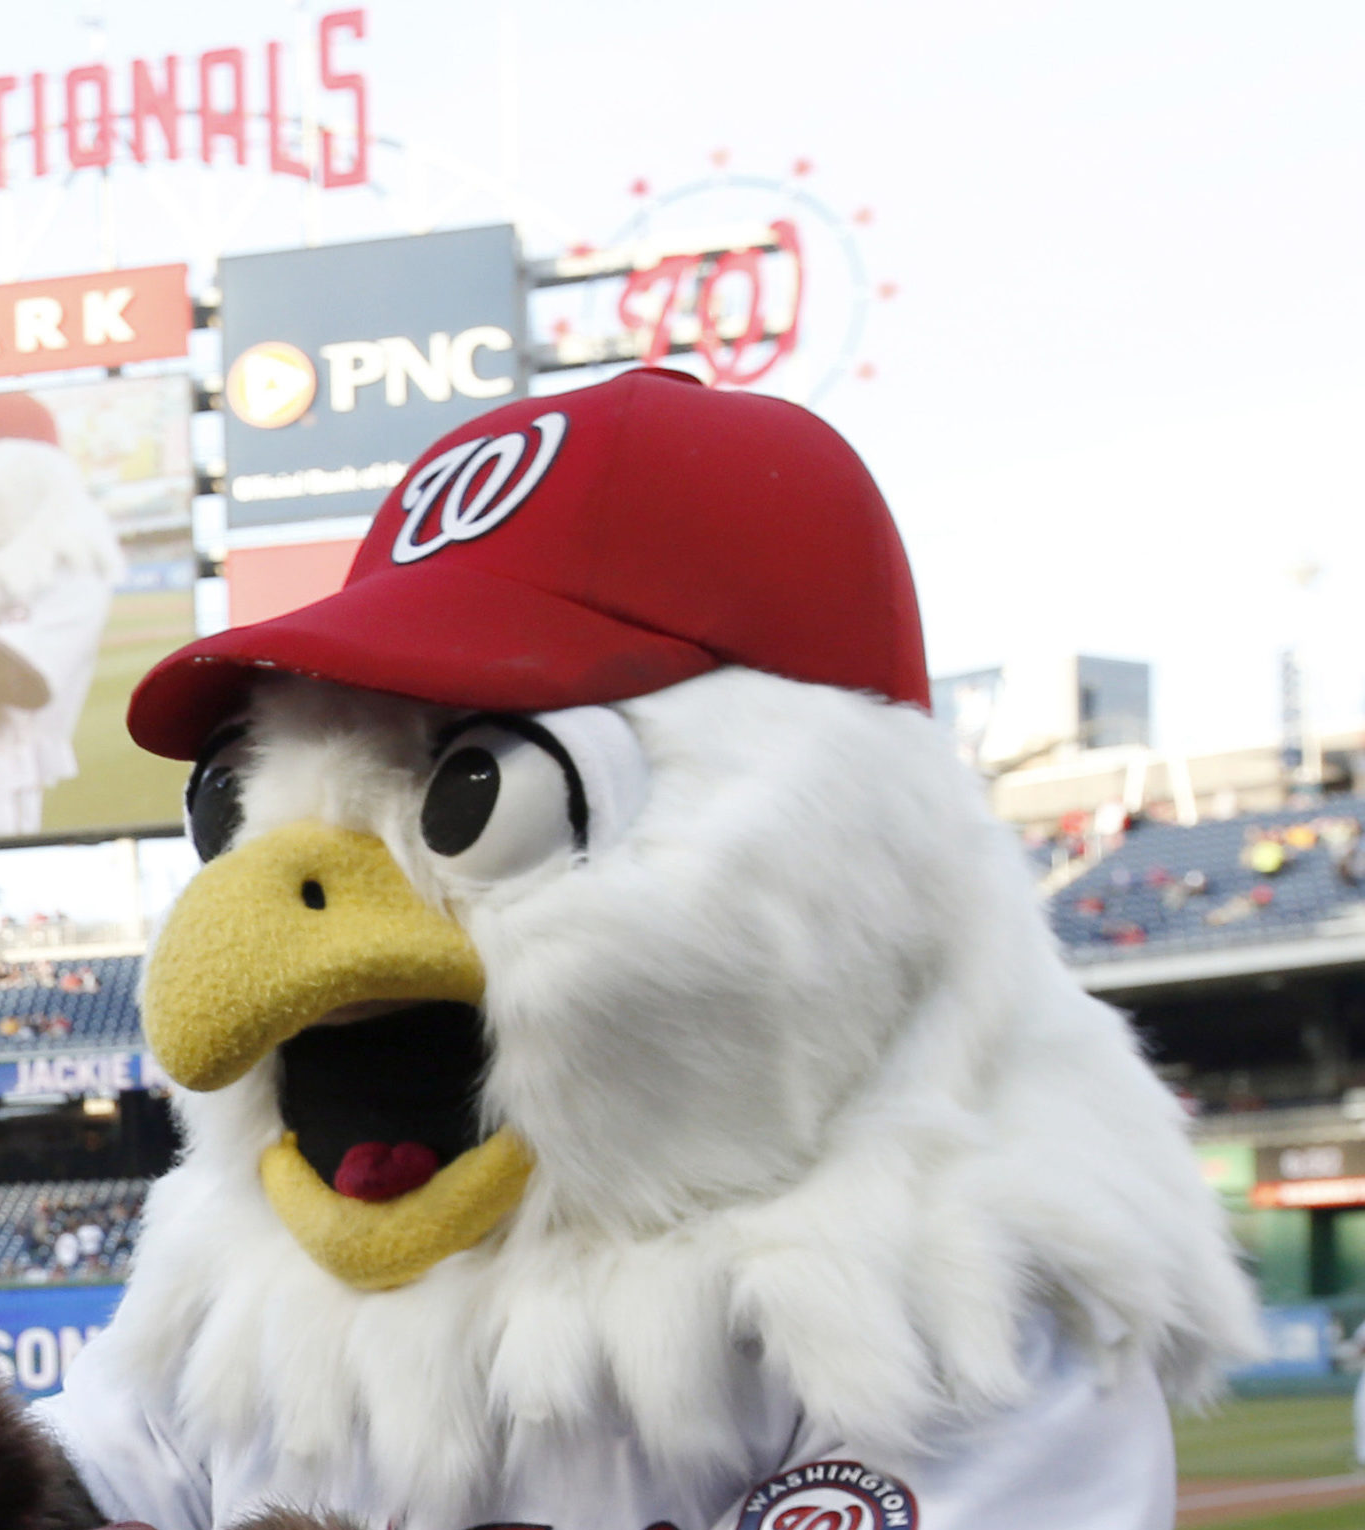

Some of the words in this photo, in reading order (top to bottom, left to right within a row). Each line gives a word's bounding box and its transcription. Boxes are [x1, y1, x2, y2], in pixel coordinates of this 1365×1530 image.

[321, 326, 515, 412] PNC
[392, 411, 568, 565] W
[16, 1053, 133, 1095] JACKIE
[746, 1464, 909, 1528] WASHINGTON
